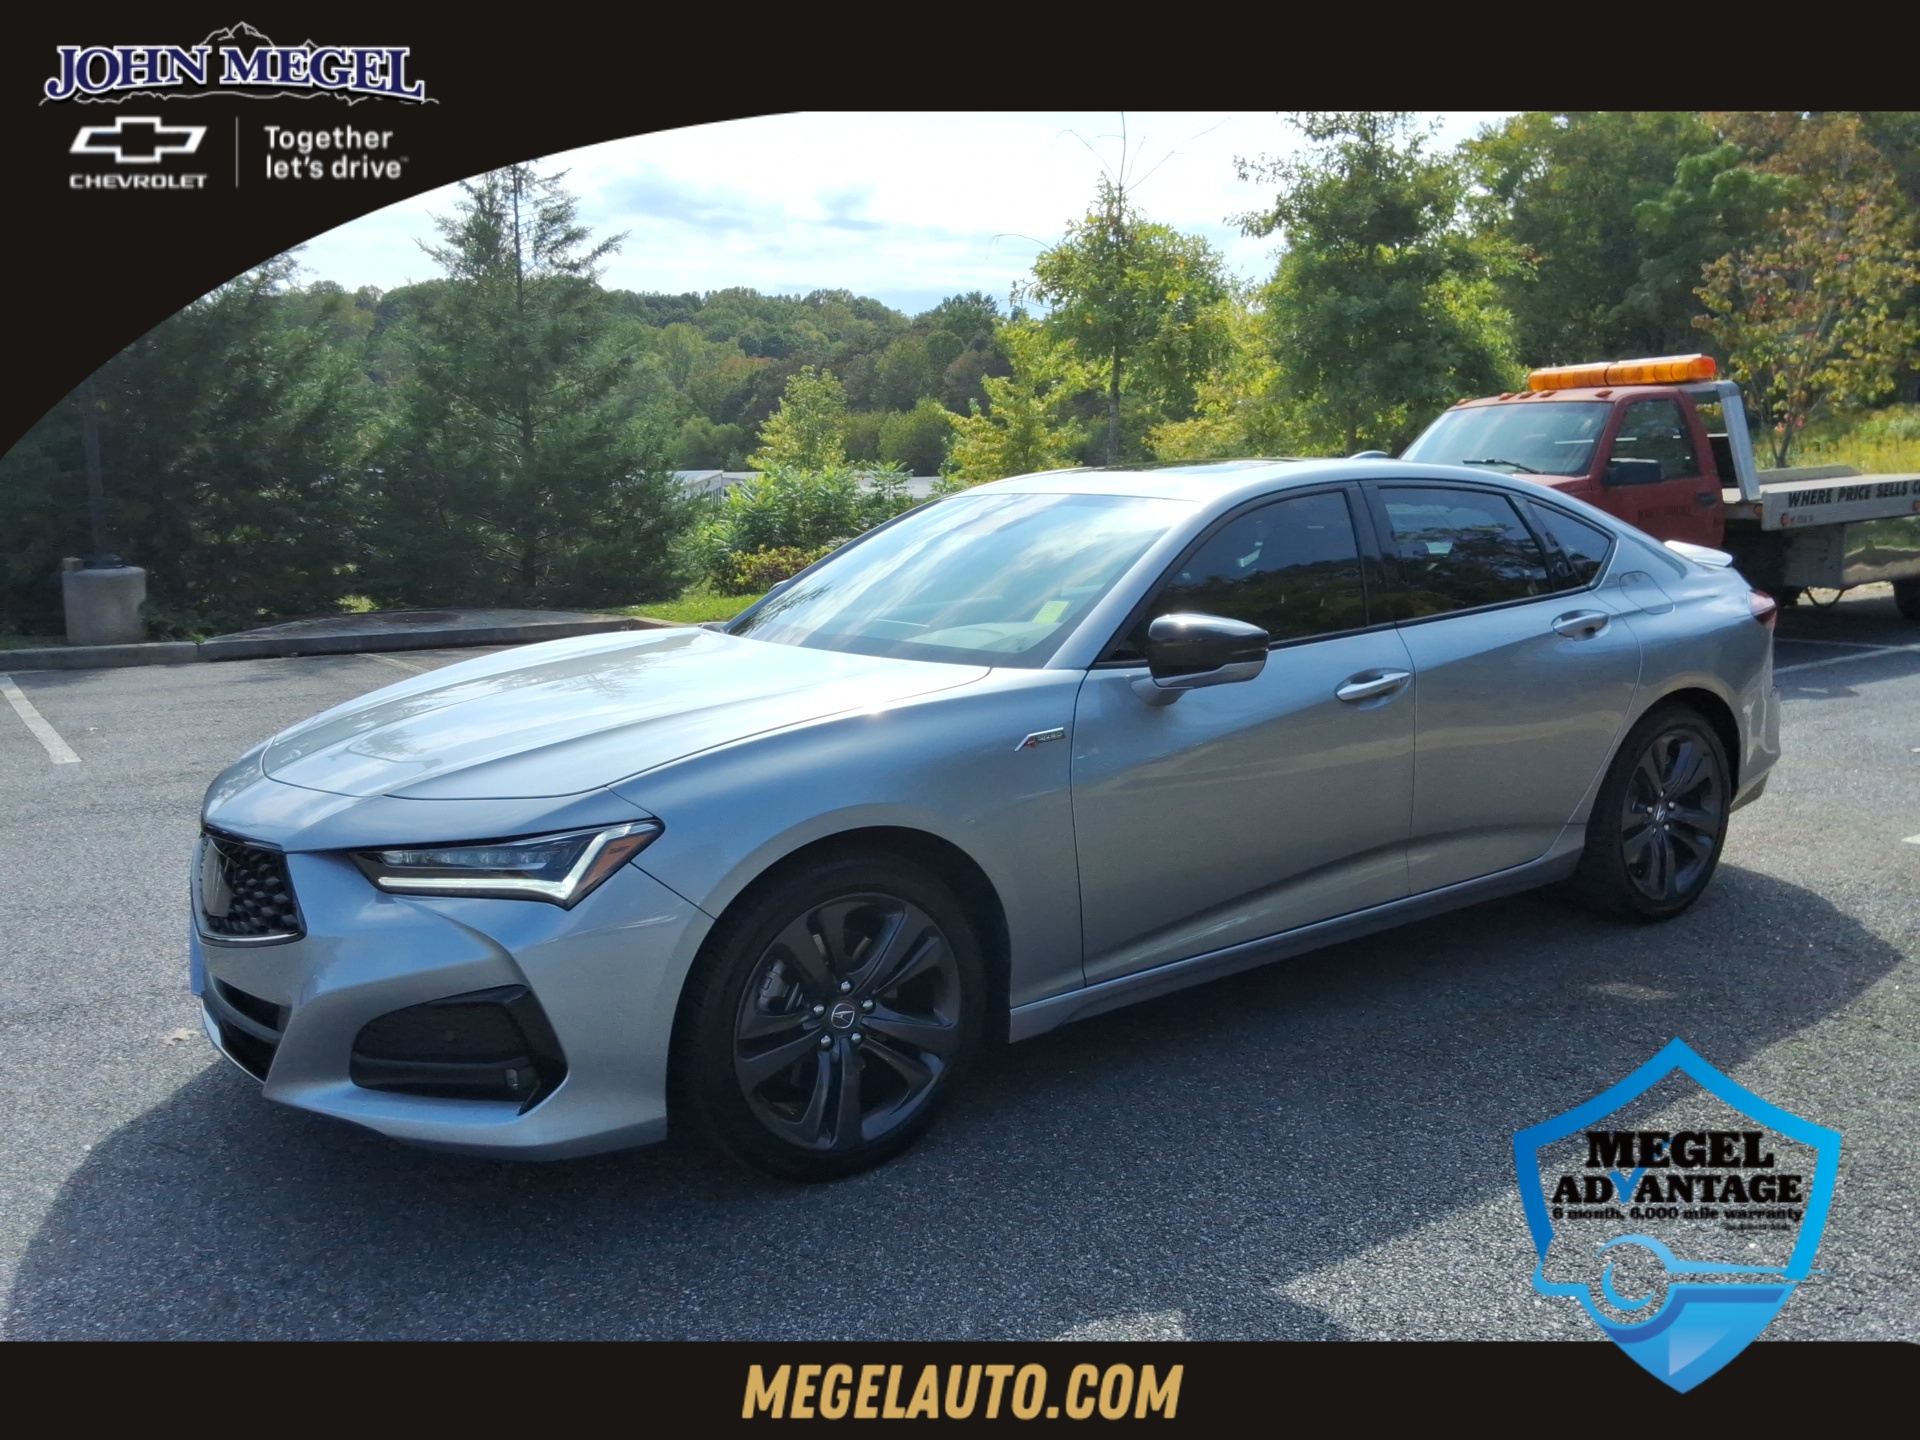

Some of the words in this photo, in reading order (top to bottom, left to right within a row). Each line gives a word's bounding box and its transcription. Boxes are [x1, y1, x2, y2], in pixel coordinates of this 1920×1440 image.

[1788, 488, 1833, 508] WHERE
[1838, 484, 1872, 502] PRICE
[1876, 481, 1908, 498] SELLS
